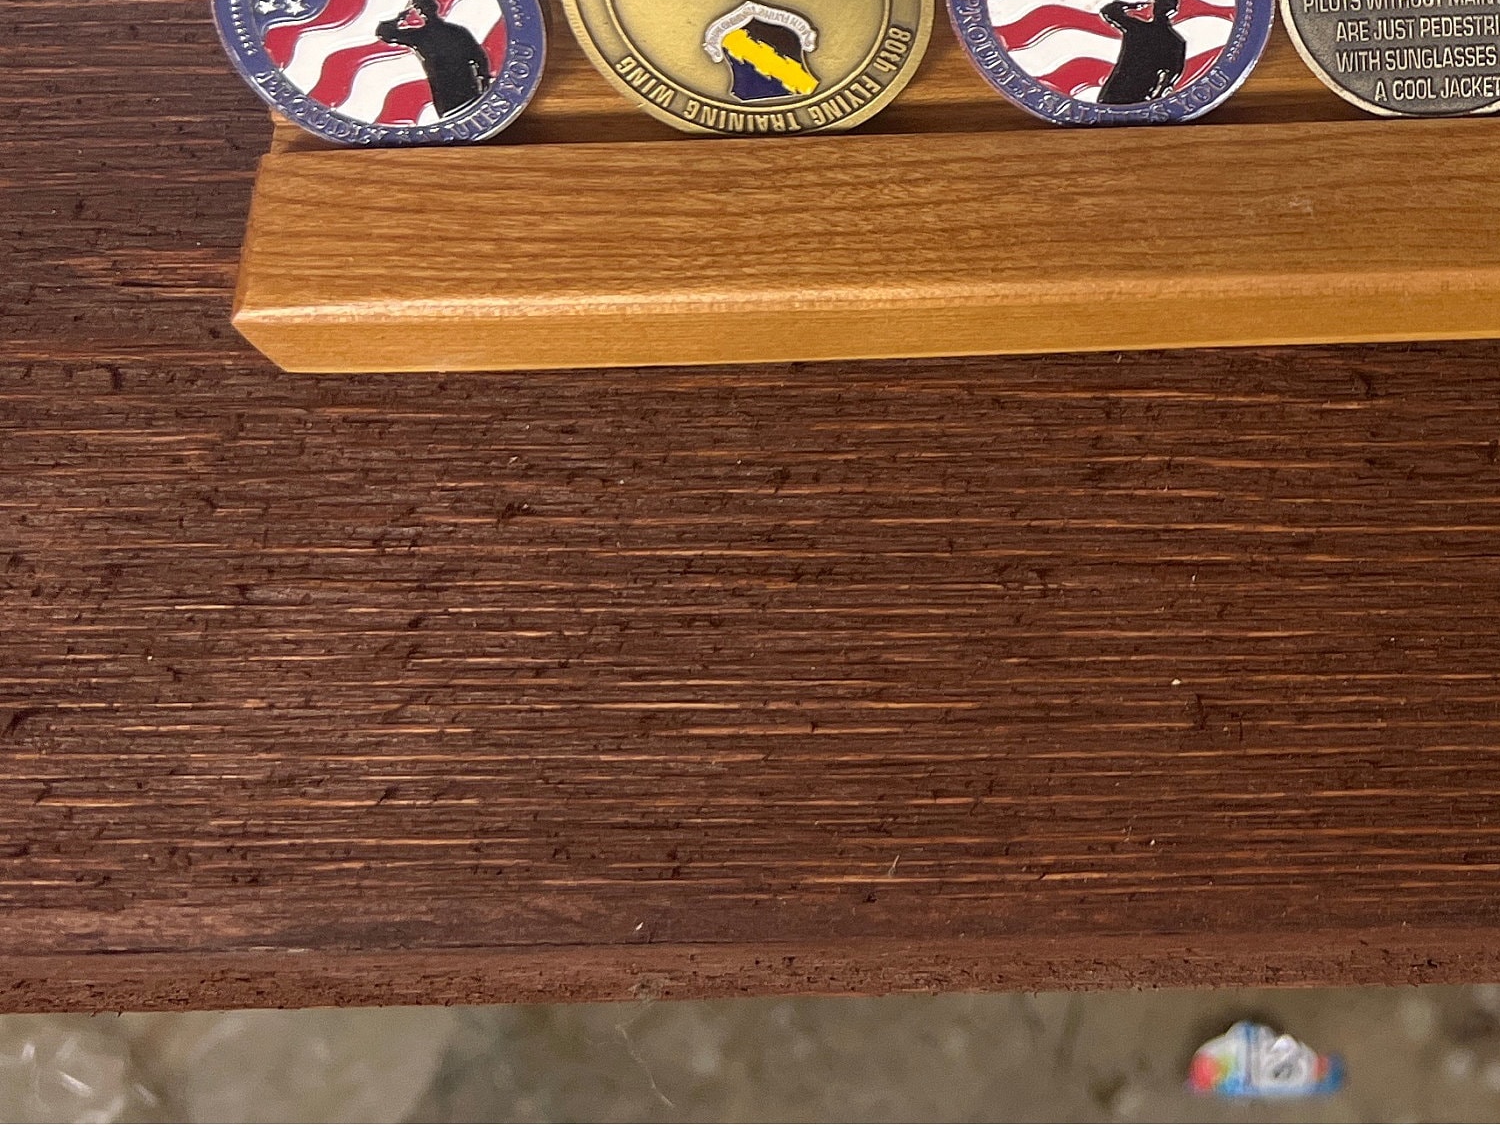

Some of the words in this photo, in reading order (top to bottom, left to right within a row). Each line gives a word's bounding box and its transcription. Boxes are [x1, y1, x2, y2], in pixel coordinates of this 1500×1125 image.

[878, 24, 914, 74] 80th
[1335, 21, 1371, 42] ARE
[1373, 18, 1418, 40] JUST
[505, 39, 537, 97] YOU
[1335, 48, 1382, 72] WITH
[1384, 45, 1497, 70] SUNGLASSES
[615, 55, 675, 109] WING
[809, 81, 881, 125] FLYING
[1170, 65, 1231, 114] YOU
[1374, 82, 1388, 102] A
[1392, 78, 1437, 100] COOL
[684, 102, 801, 135] TRAINING
